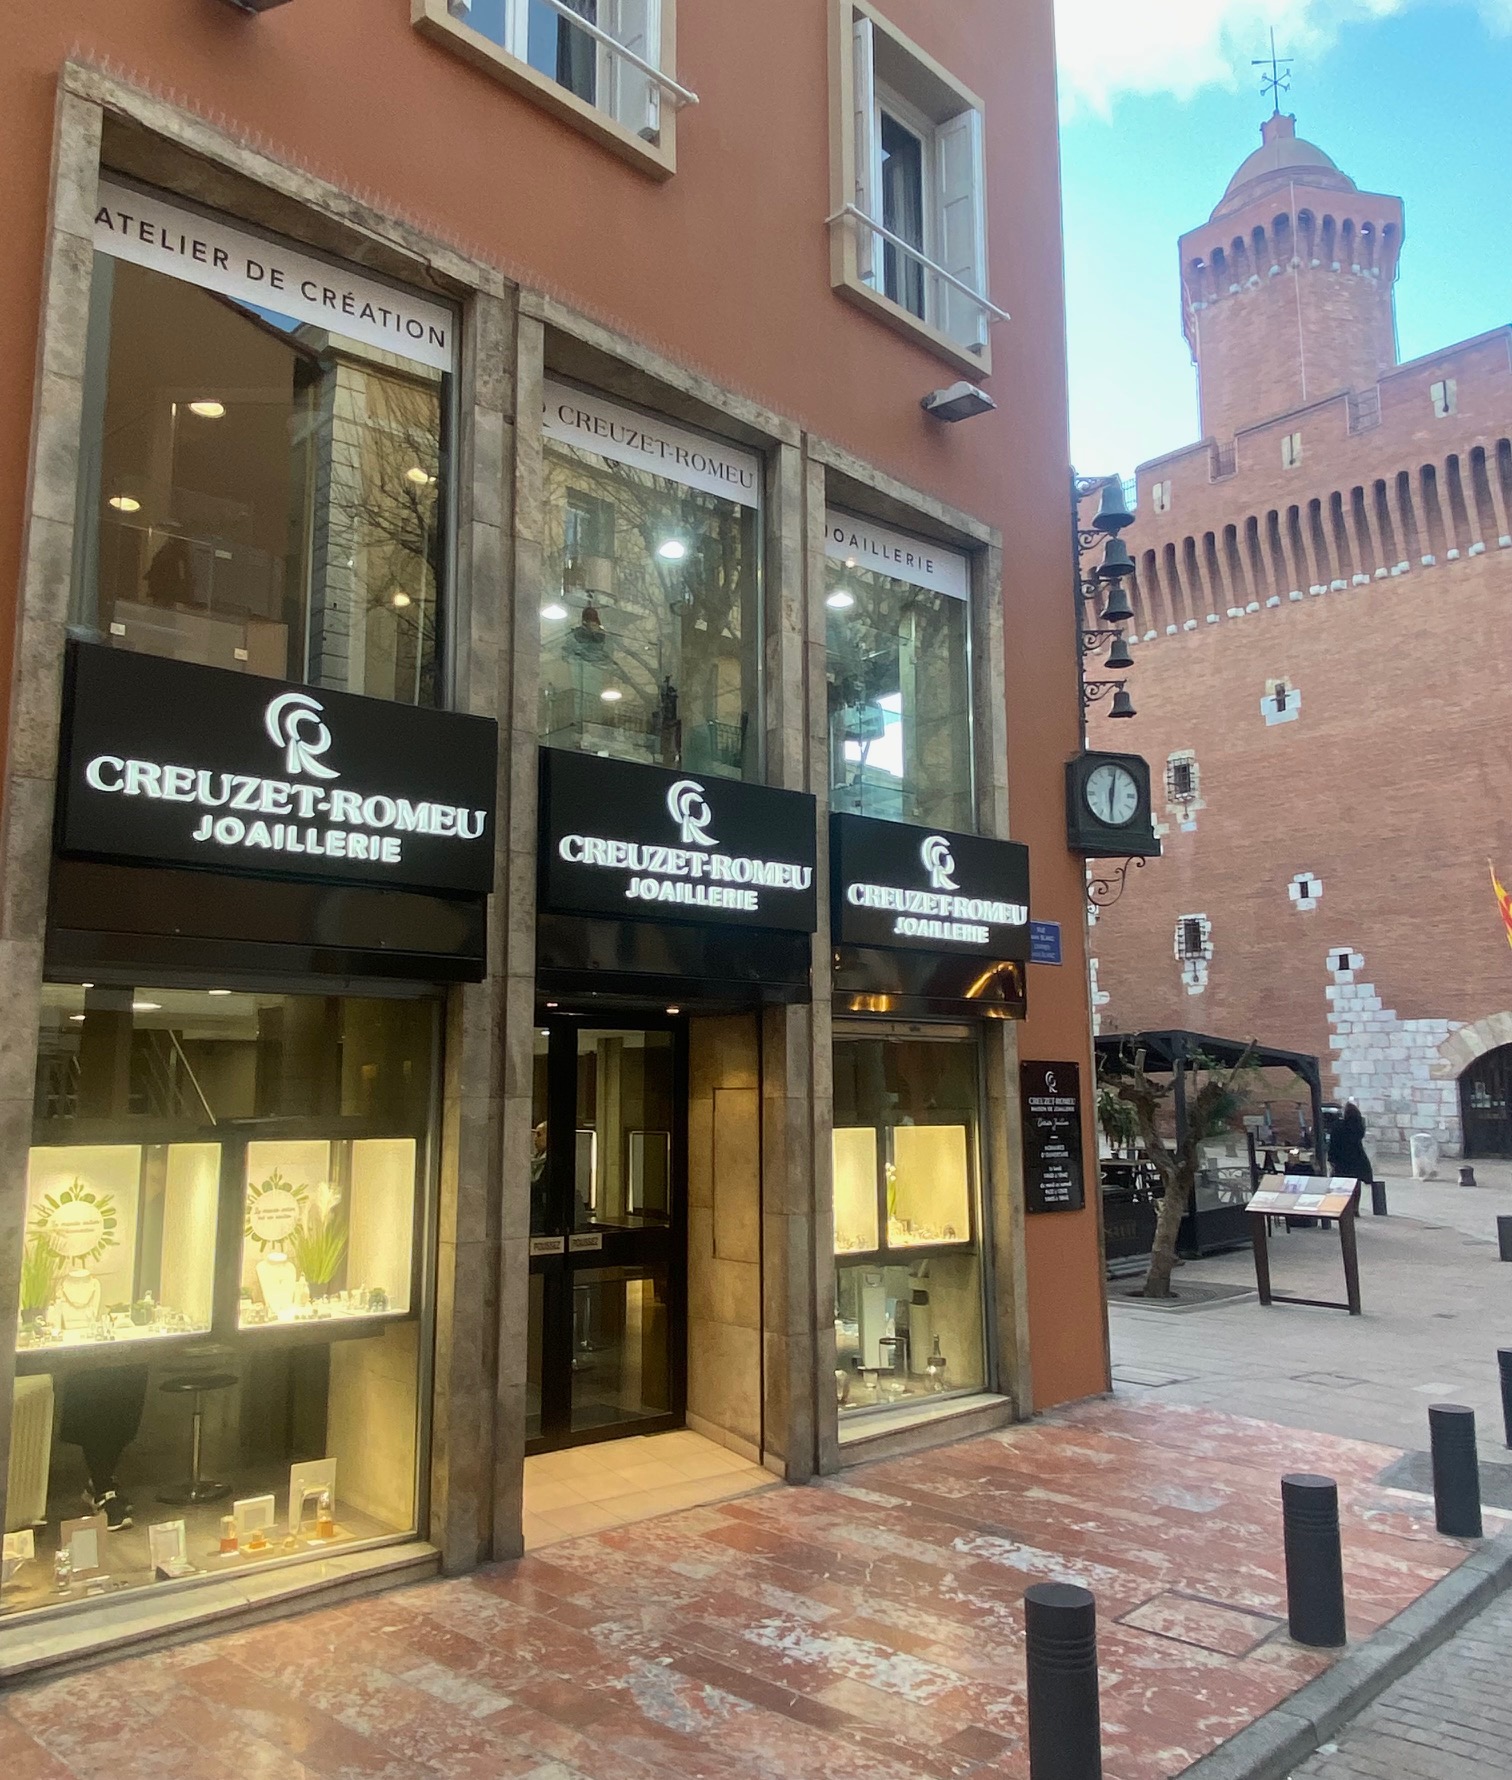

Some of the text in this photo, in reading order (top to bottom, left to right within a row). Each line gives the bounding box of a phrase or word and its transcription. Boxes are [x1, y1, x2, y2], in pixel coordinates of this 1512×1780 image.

[95, 207, 445, 348] ATELIER DE CRÉATION
[558, 404, 753, 489] CREUZET-ROMEU
[86, 755, 487, 839] CREUZET-ROMEU
[193, 815, 402, 863] JOAILLERIE
[558, 834, 813, 890] CREUZET-ROMEU
[625, 877, 759, 911] JOAILLERIE
[847, 883, 1028, 925] CREUZET-ROMEU
[893, 916, 990, 943] JOAILLERIE
